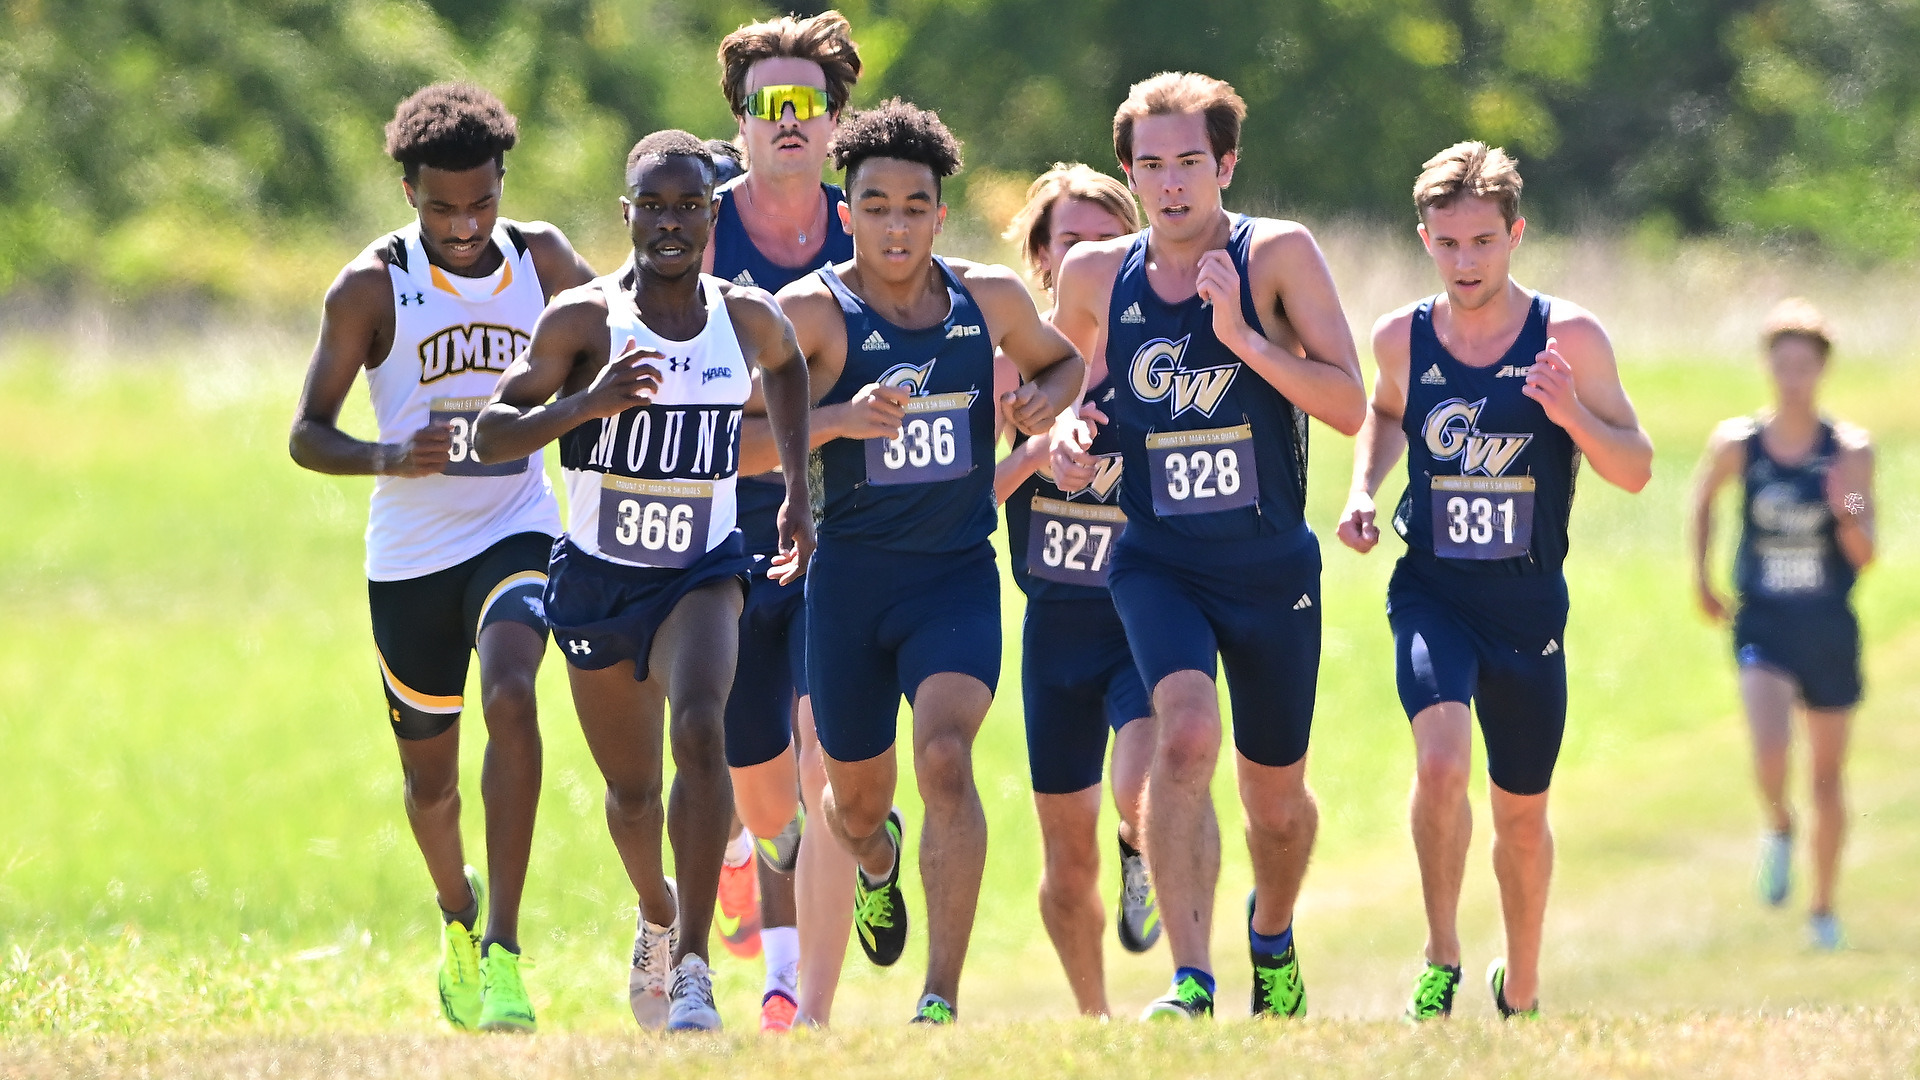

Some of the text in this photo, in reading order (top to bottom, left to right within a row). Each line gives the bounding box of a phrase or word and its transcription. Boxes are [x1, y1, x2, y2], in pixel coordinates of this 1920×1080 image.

[702, 367, 732, 385] MAAC
[1128, 333, 1241, 420] GW
[447, 416, 480, 462] 3
[588, 410, 743, 473] MOUNT
[883, 417, 955, 470] 336
[1421, 397, 1533, 477] GW
[1165, 448, 1240, 500] 328
[615, 499, 694, 553] 366
[1043, 520, 1112, 571] 327
[1447, 496, 1514, 544] 331
